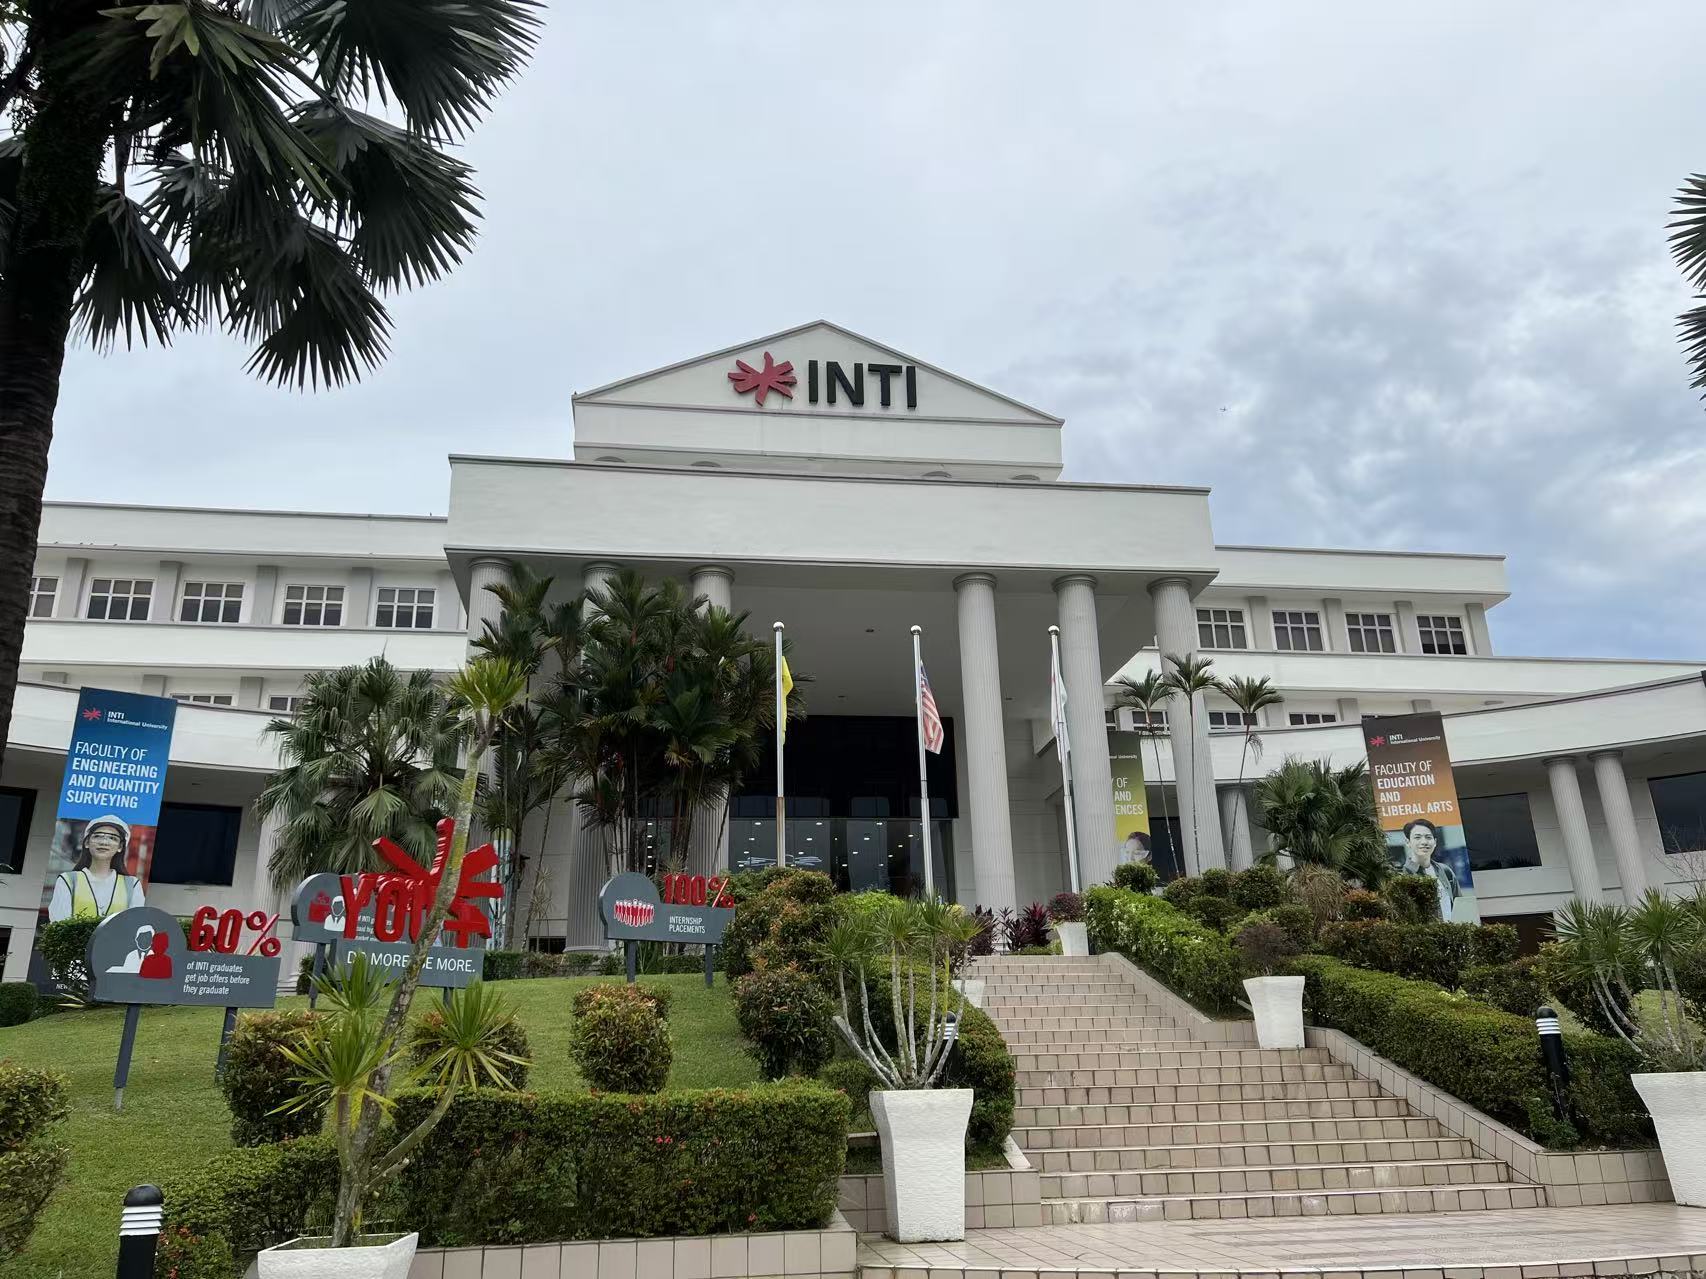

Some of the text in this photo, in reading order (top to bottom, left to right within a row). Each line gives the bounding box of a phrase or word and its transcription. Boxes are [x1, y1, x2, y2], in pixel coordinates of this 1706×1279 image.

[808, 360, 917, 408] INTI
[107, 711, 125, 720] INTI
[142, 722, 168, 730] University
[75, 741, 148, 761] FACULTY OF
[72, 758, 158, 779] ENGINEERING
[1375, 760, 1432, 776] FACULTY OF
[68, 773, 160, 795] AND QUANTITY
[1116, 777, 1128, 788] OF
[1377, 774, 1435, 789] EDUCATION
[66, 790, 139, 809] SURVEYING
[1114, 790, 1132, 801] AND
[1379, 791, 1400, 803] AND
[1115, 804, 1144, 815] ENCES
[1382, 801, 1453, 817] LIBERAL ARTS
[663, 874, 735, 909] 100%
[669, 916, 703, 925] INTERNSHIP
[191, 906, 281, 957] 60%
[669, 924, 706, 934] PLACEMENTS
[186, 961, 243, 973] of INTI graduates
[347, 951, 367, 964] D
[436, 957, 476, 973] MORE.
[184, 973, 250, 985] get job offers before
[183, 984, 230, 995] they graduate
